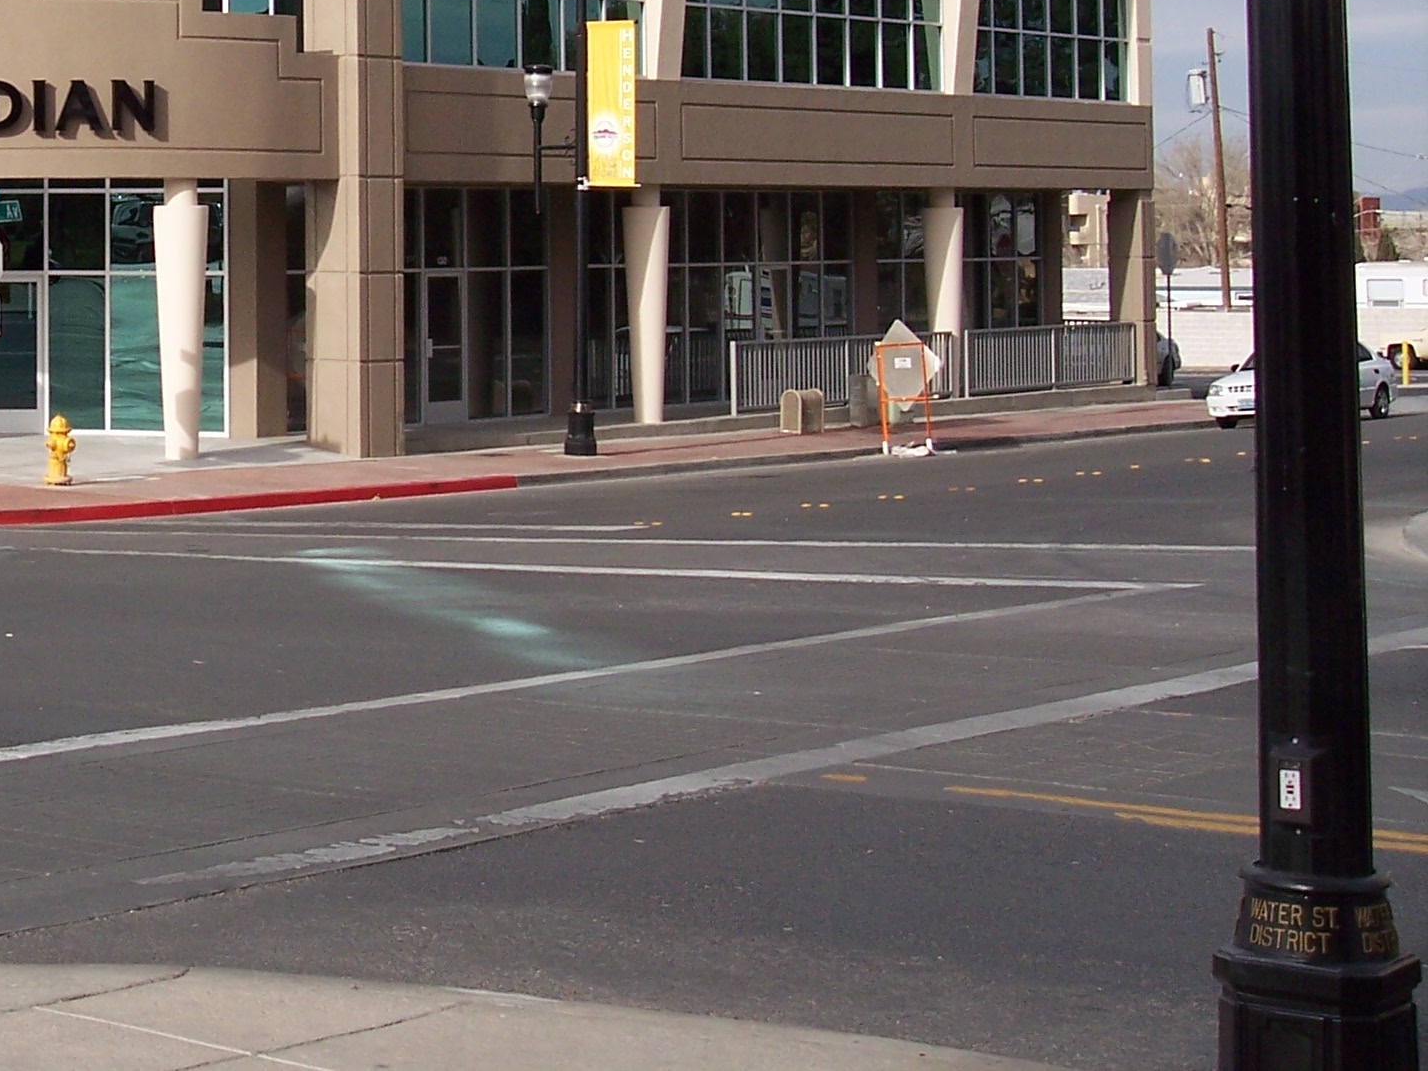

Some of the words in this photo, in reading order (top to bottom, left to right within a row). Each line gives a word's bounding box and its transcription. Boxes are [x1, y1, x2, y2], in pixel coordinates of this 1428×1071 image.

[621, 27, 634, 179] HENDERSON
[1251, 896, 1303, 926] WATER
[1249, 923, 1331, 955] DISTRICT
